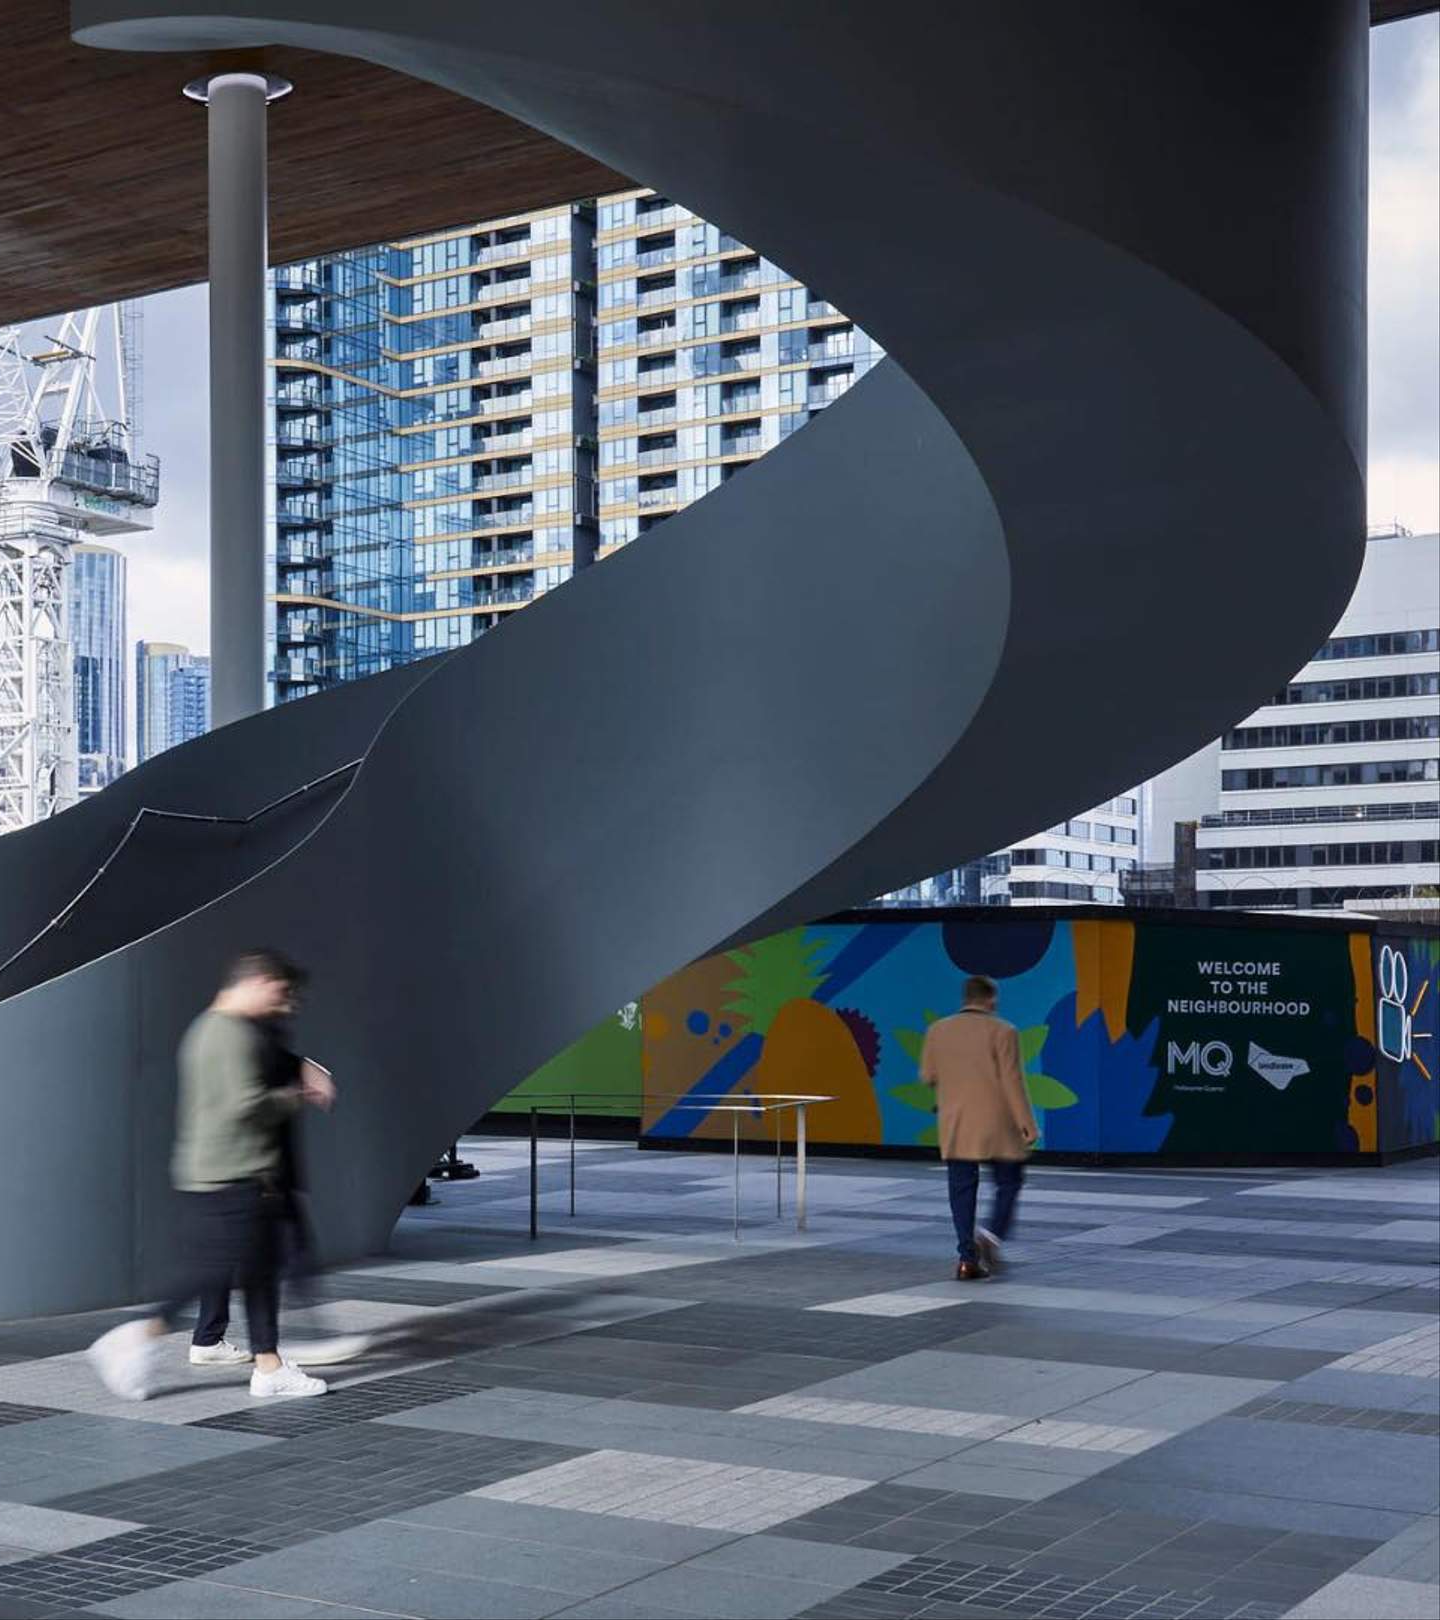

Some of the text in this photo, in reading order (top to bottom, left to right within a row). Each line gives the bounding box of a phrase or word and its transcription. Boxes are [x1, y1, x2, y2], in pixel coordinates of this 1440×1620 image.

[1198, 961, 1281, 975] WELCOME
[1210, 981, 1268, 995] TO THE
[1167, 999, 1310, 1015] NEIGHBOURHOOD
[1167, 1040, 1233, 1077] MQ
